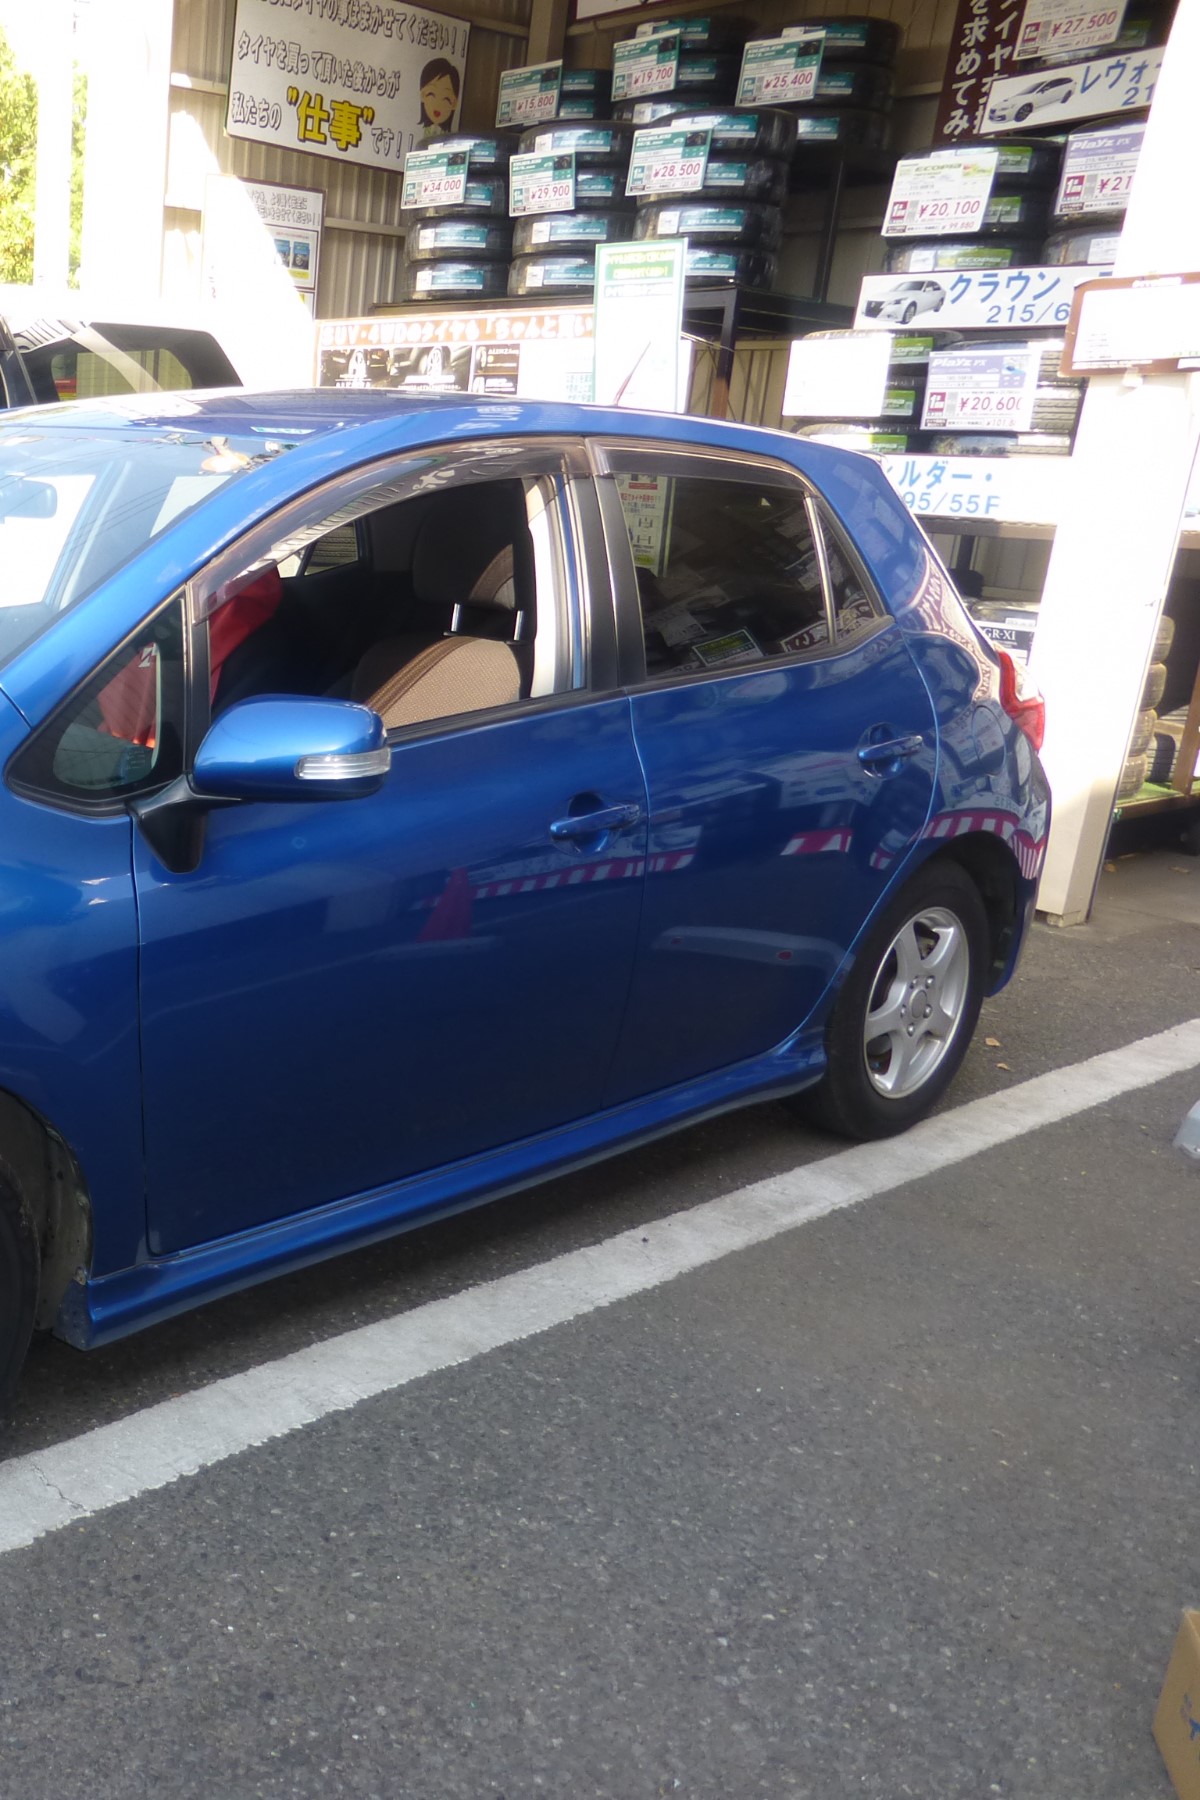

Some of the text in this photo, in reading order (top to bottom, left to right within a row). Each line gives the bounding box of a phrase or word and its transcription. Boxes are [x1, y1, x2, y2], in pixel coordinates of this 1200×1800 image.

[1051, 11, 1118, 38] ¥27,500
[633, 66, 673, 85] ¥19,700
[763, 72, 813, 90] ¥25,400
[517, 95, 555, 111] ¥15,800
[653, 163, 700, 178] ¥28,500
[423, 179, 462, 193] ¥34,000
[531, 184, 570, 200] ¥29,900
[918, 200, 981, 219] ¥20,100
[948, 270, 1061, 305] クラウン
[986, 302, 1071, 324] 215/6
[886, 460, 993, 490] ルダー・
[982, 628, 1016, 641] GR-XI
